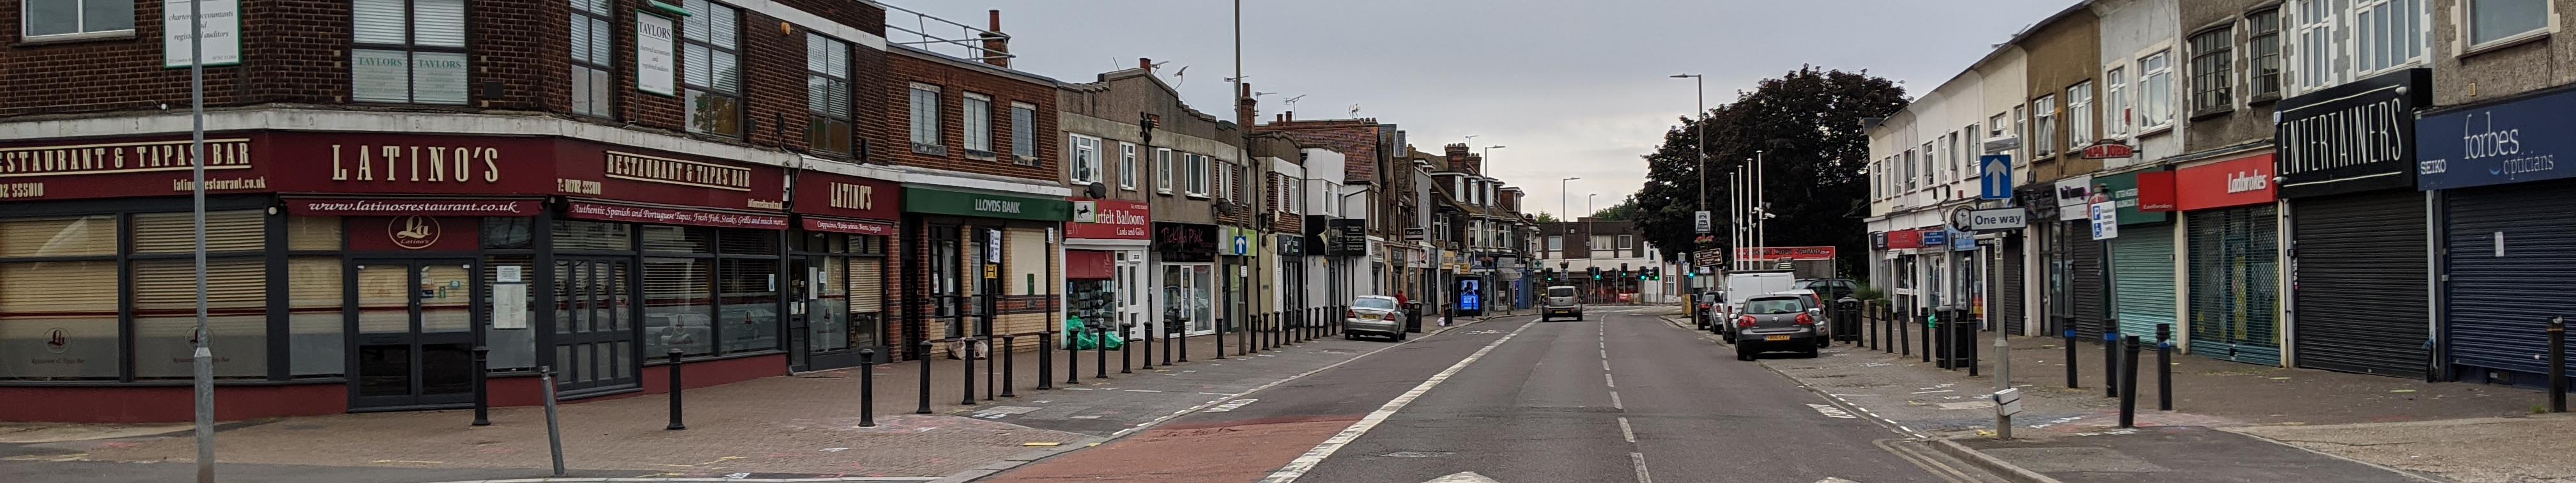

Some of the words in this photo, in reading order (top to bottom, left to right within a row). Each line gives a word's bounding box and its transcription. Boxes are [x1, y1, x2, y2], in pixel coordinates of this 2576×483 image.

[204, 30, 229, 38] auditors
[639, 22, 671, 40] TAYLORS
[358, 57, 402, 66] TAYLORS
[418, 59, 461, 68] TAYLORS
[2282, 98, 2402, 175] ENTERTAINERS
[2464, 110, 2519, 160] forbes
[114, 148, 124, 169] &
[212, 142, 250, 165] BAR
[2085, 145, 2104, 158] PAPA
[332, 144, 498, 183] LATINO'S
[607, 154, 682, 181] RESTAURANT
[686, 164, 693, 181] &
[696, 165, 728, 185] TAPAS
[732, 169, 750, 187] BAR
[2420, 158, 2446, 175] SEIKO
[2503, 150, 2554, 180] opticians
[173, 176, 266, 191] latinoestaurant.co.uk
[557, 178, 564, 192] T:
[2228, 169, 2267, 194] Ladbrokes
[12, 182, 44, 198] 555010
[830, 182, 871, 210] LATINO'S
[309, 200, 521, 213] www.latinosrestaurant.co.uk
[975, 199, 1001, 212] LLOYDS
[1002, 201, 1020, 213] BANK
[572, 204, 605, 215] Authentic
[605, 206, 631, 218] Spanish
[631, 208, 643, 217] and
[643, 209, 675, 221] Portuguese
[675, 211, 693, 222] Tapas,
[694, 212, 708, 222] Fresh
[738, 216, 751, 225] Grills
[1116, 210, 1144, 225] Balloons
[1975, 215, 1997, 225] One
[1999, 215, 2021, 225] way
[1116, 227, 1128, 236] Cards
[1135, 227, 1144, 236] Gifts
[1189, 227, 1203, 243] Pink
[986, 266, 996, 277] H
